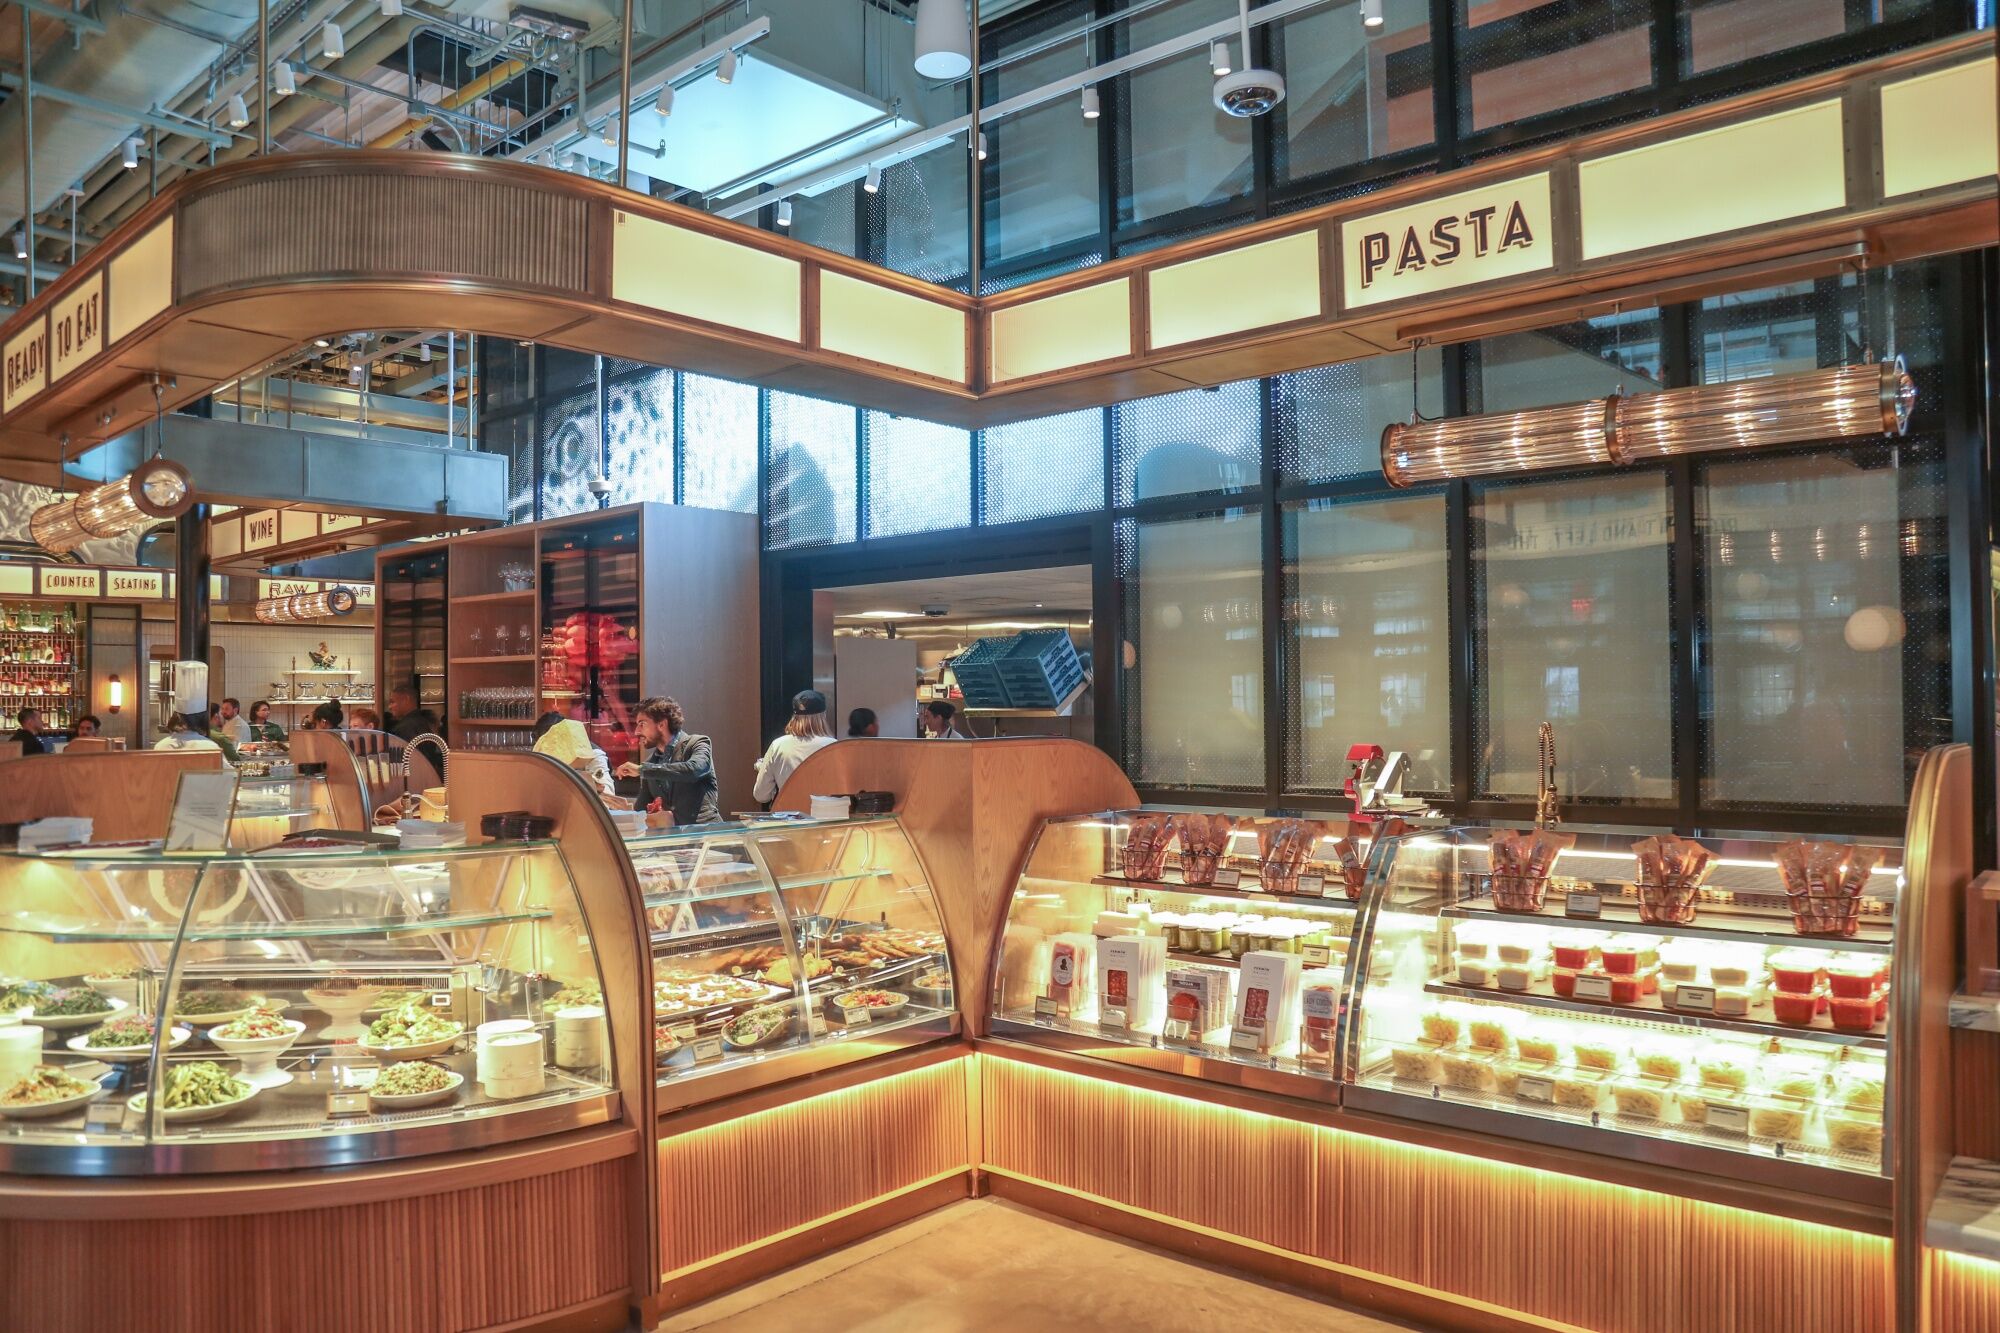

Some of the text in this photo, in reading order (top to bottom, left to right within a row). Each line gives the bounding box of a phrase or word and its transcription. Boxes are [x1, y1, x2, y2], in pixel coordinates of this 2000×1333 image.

[1360, 200, 1533, 289] PASTA
[7, 292, 98, 400] READY TO EAT
[249, 517, 273, 543] WINE
[46, 574, 157, 591] COUNTER SEATING
[269, 582, 309, 599] RAW
